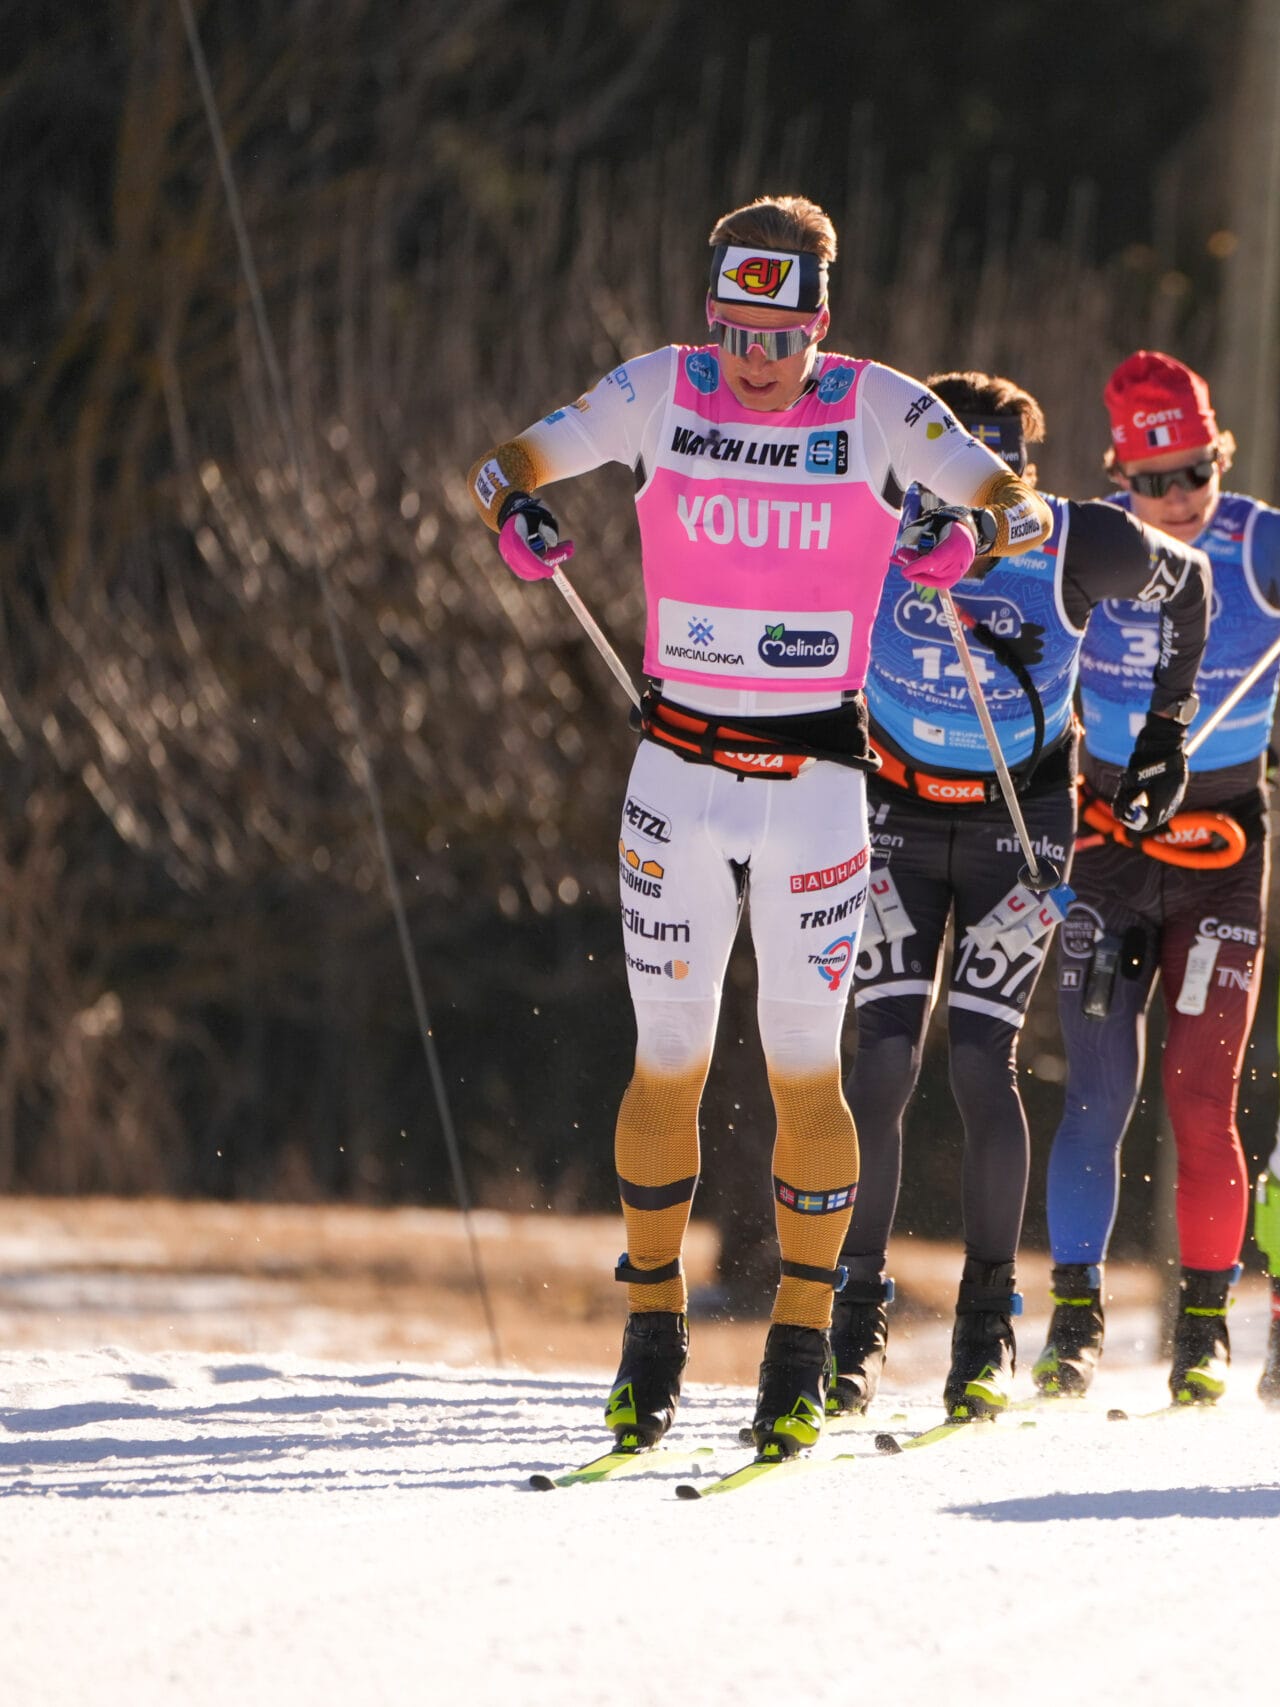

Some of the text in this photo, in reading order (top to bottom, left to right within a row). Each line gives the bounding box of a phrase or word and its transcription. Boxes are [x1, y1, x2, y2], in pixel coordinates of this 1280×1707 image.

[744, 442, 799, 468] LIVE
[838, 439, 847, 466] PLAY
[677, 494, 832, 550] YOUTH
[903, 600, 1014, 636] Meda
[665, 644, 744, 666] MARCIALONGA
[761, 637, 836, 657] Melinda
[1121, 627, 1160, 669] 3
[912, 647, 996, 684] 14
[926, 783, 986, 798] COXA
[624, 800, 671, 844] PETZL
[807, 953, 847, 966] Thermia
